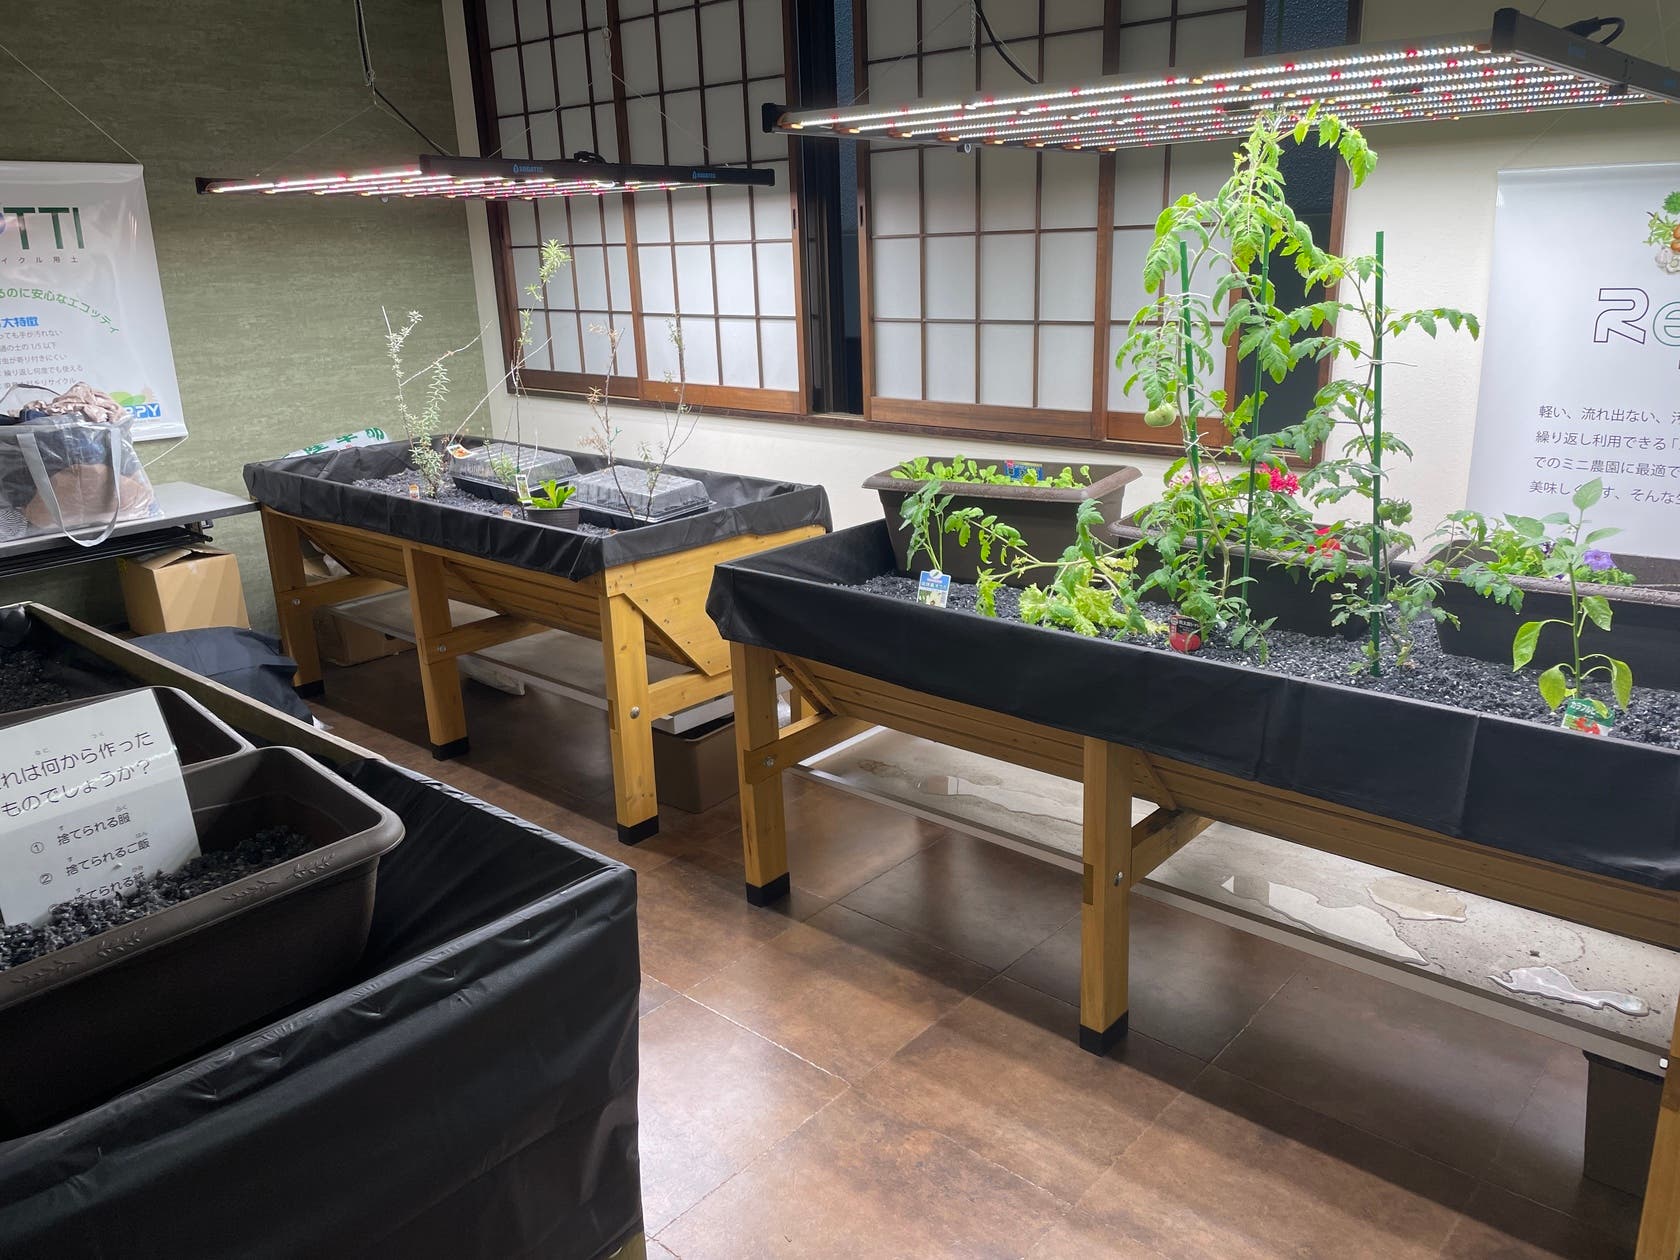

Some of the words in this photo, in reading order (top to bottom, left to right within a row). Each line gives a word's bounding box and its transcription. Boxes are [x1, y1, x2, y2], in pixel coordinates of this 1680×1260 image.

[0, 207, 85, 250] TTI
[0, 316, 39, 328] 大特徴
[1535, 430, 1680, 451] 繰り返し利用できる「
[0, 731, 154, 790] れは何から作った
[57, 812, 131, 846] 捨てられる服
